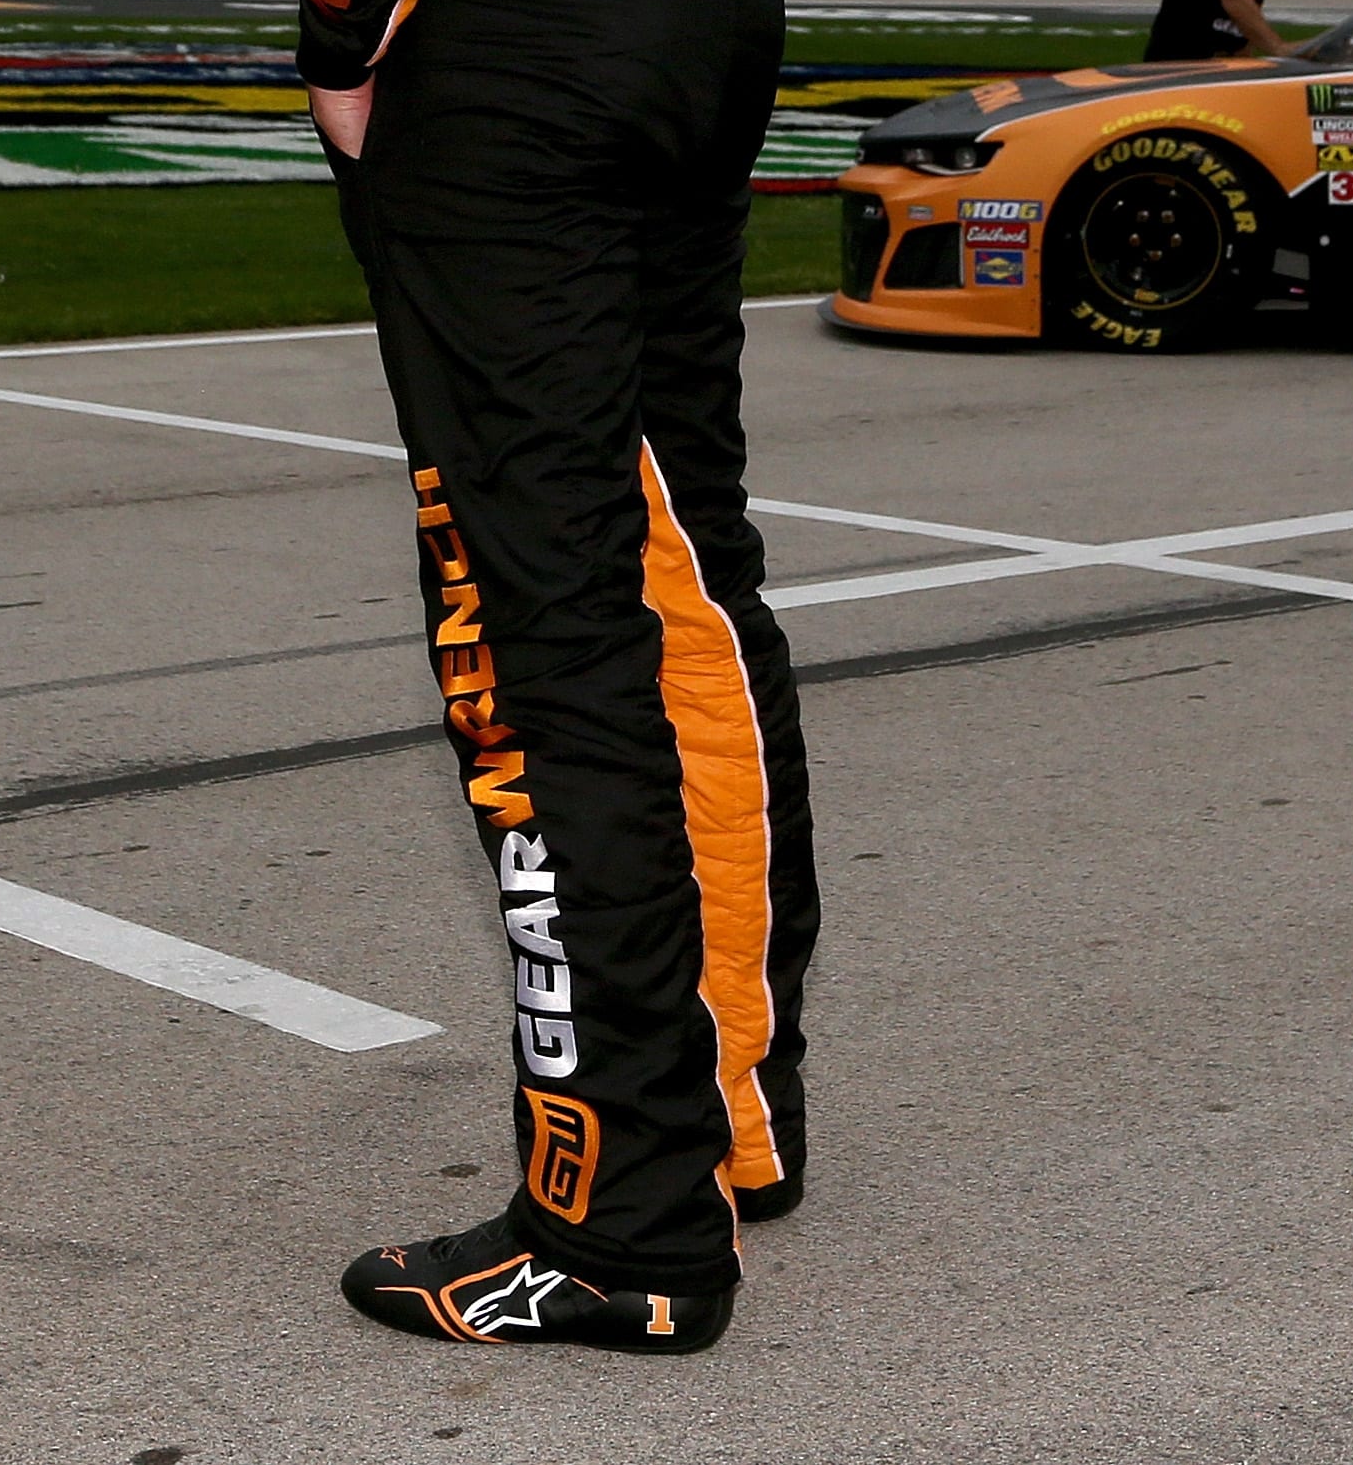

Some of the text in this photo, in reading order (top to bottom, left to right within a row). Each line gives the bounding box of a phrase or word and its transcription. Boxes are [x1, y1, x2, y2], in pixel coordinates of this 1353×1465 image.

[1093, 137, 1258, 233] GOODYEAR
[1070, 300, 1162, 348] EAGLE
[645, 1293, 675, 1335] 1
